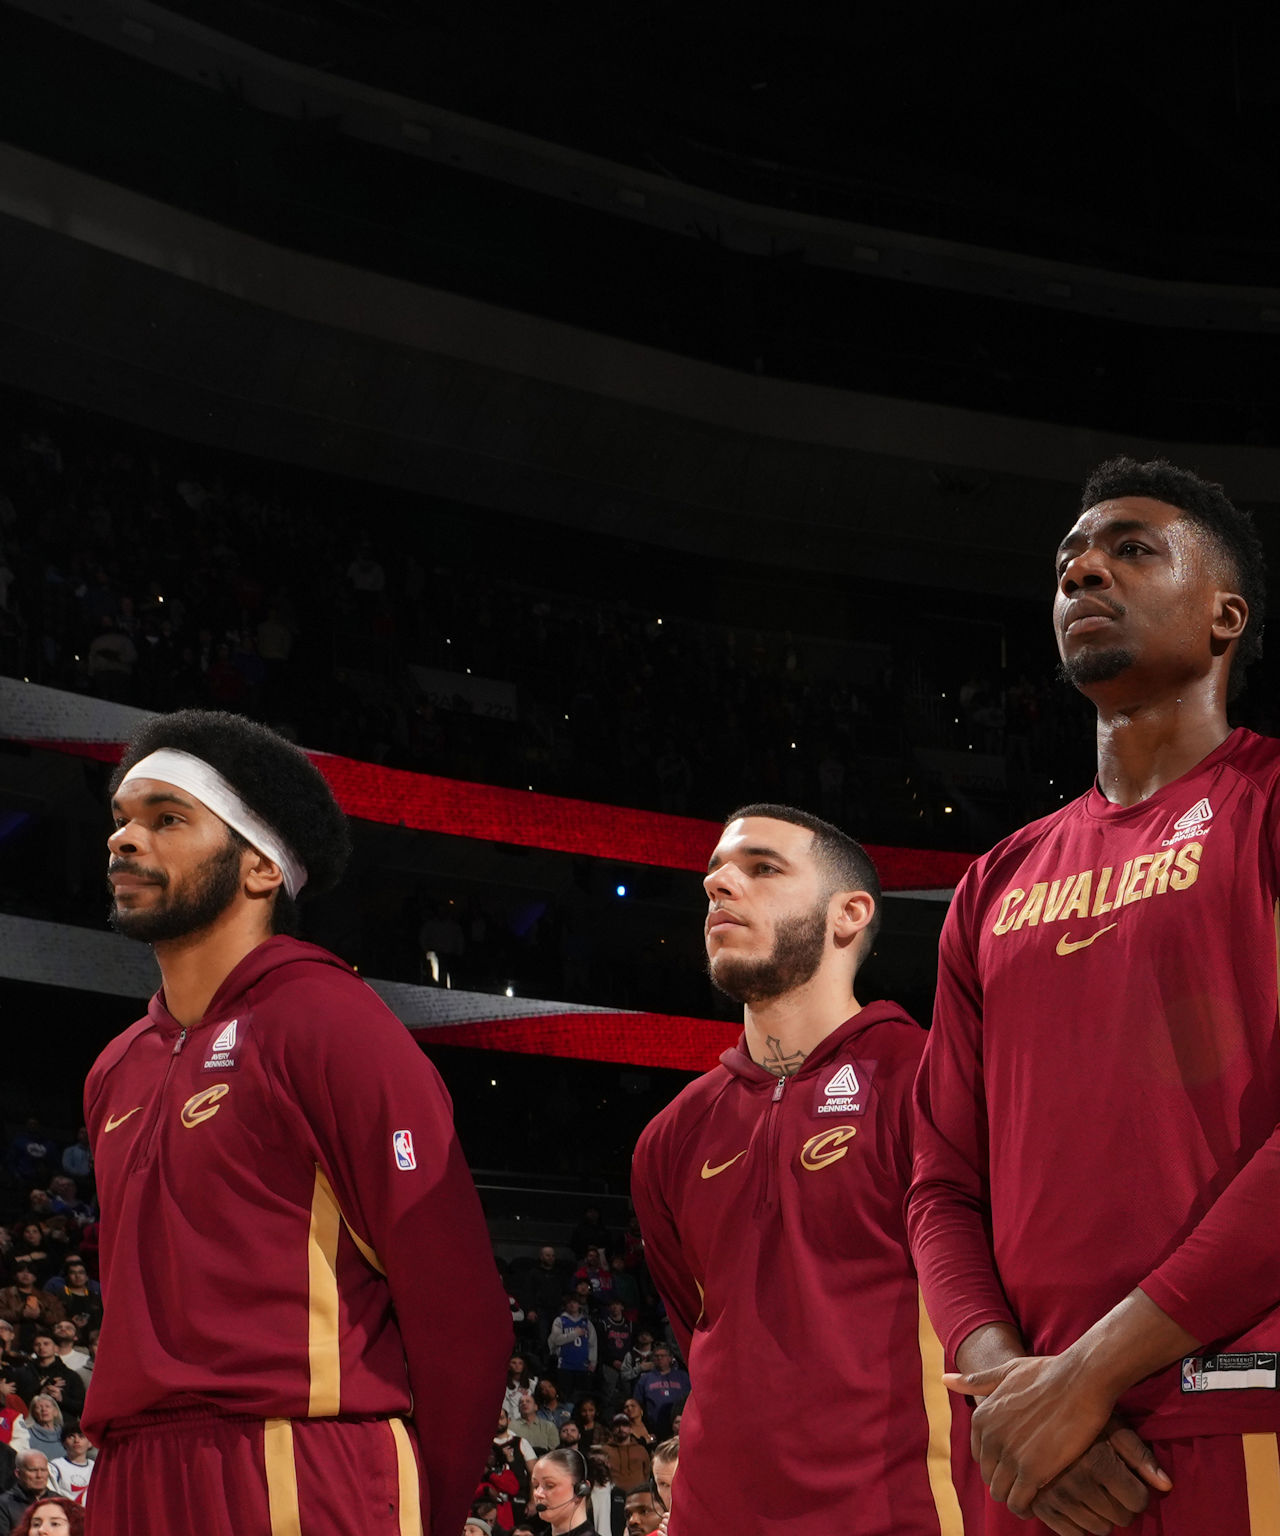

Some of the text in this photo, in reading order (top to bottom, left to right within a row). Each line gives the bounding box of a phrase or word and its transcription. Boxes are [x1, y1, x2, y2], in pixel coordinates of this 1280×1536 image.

[1161, 826, 1211, 847] DENNISON
[1172, 823, 1204, 839] AVERY
[992, 842, 1203, 936] CAVALIERS
[204, 1059, 235, 1068] DENNISON
[211, 1052, 231, 1061] AVERY
[180, 1083, 230, 1129] C
[817, 1103, 860, 1113] DENNISON
[825, 1097, 853, 1106] AVERY
[800, 1125, 857, 1171] C
